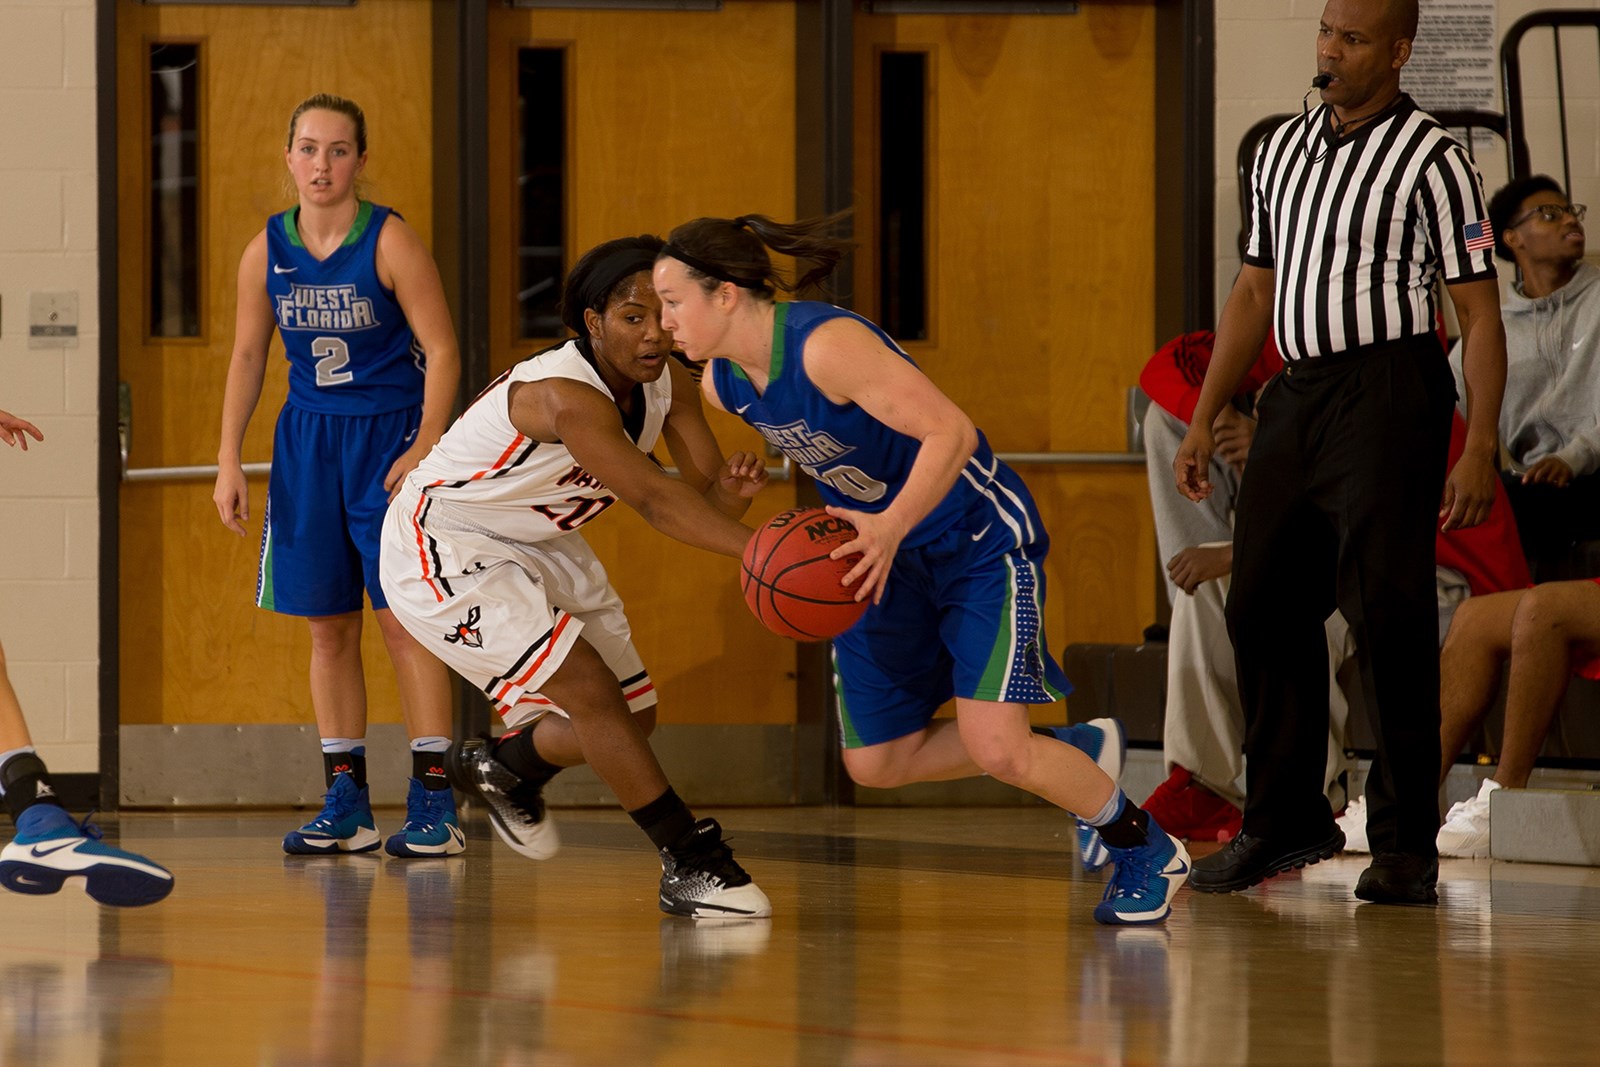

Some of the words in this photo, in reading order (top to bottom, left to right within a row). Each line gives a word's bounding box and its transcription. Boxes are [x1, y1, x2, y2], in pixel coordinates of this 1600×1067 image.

[295, 288, 352, 310] WEST
[281, 299, 372, 328] FLORIDA
[311, 336, 354, 387] 2
[804, 517, 856, 541] NCA
